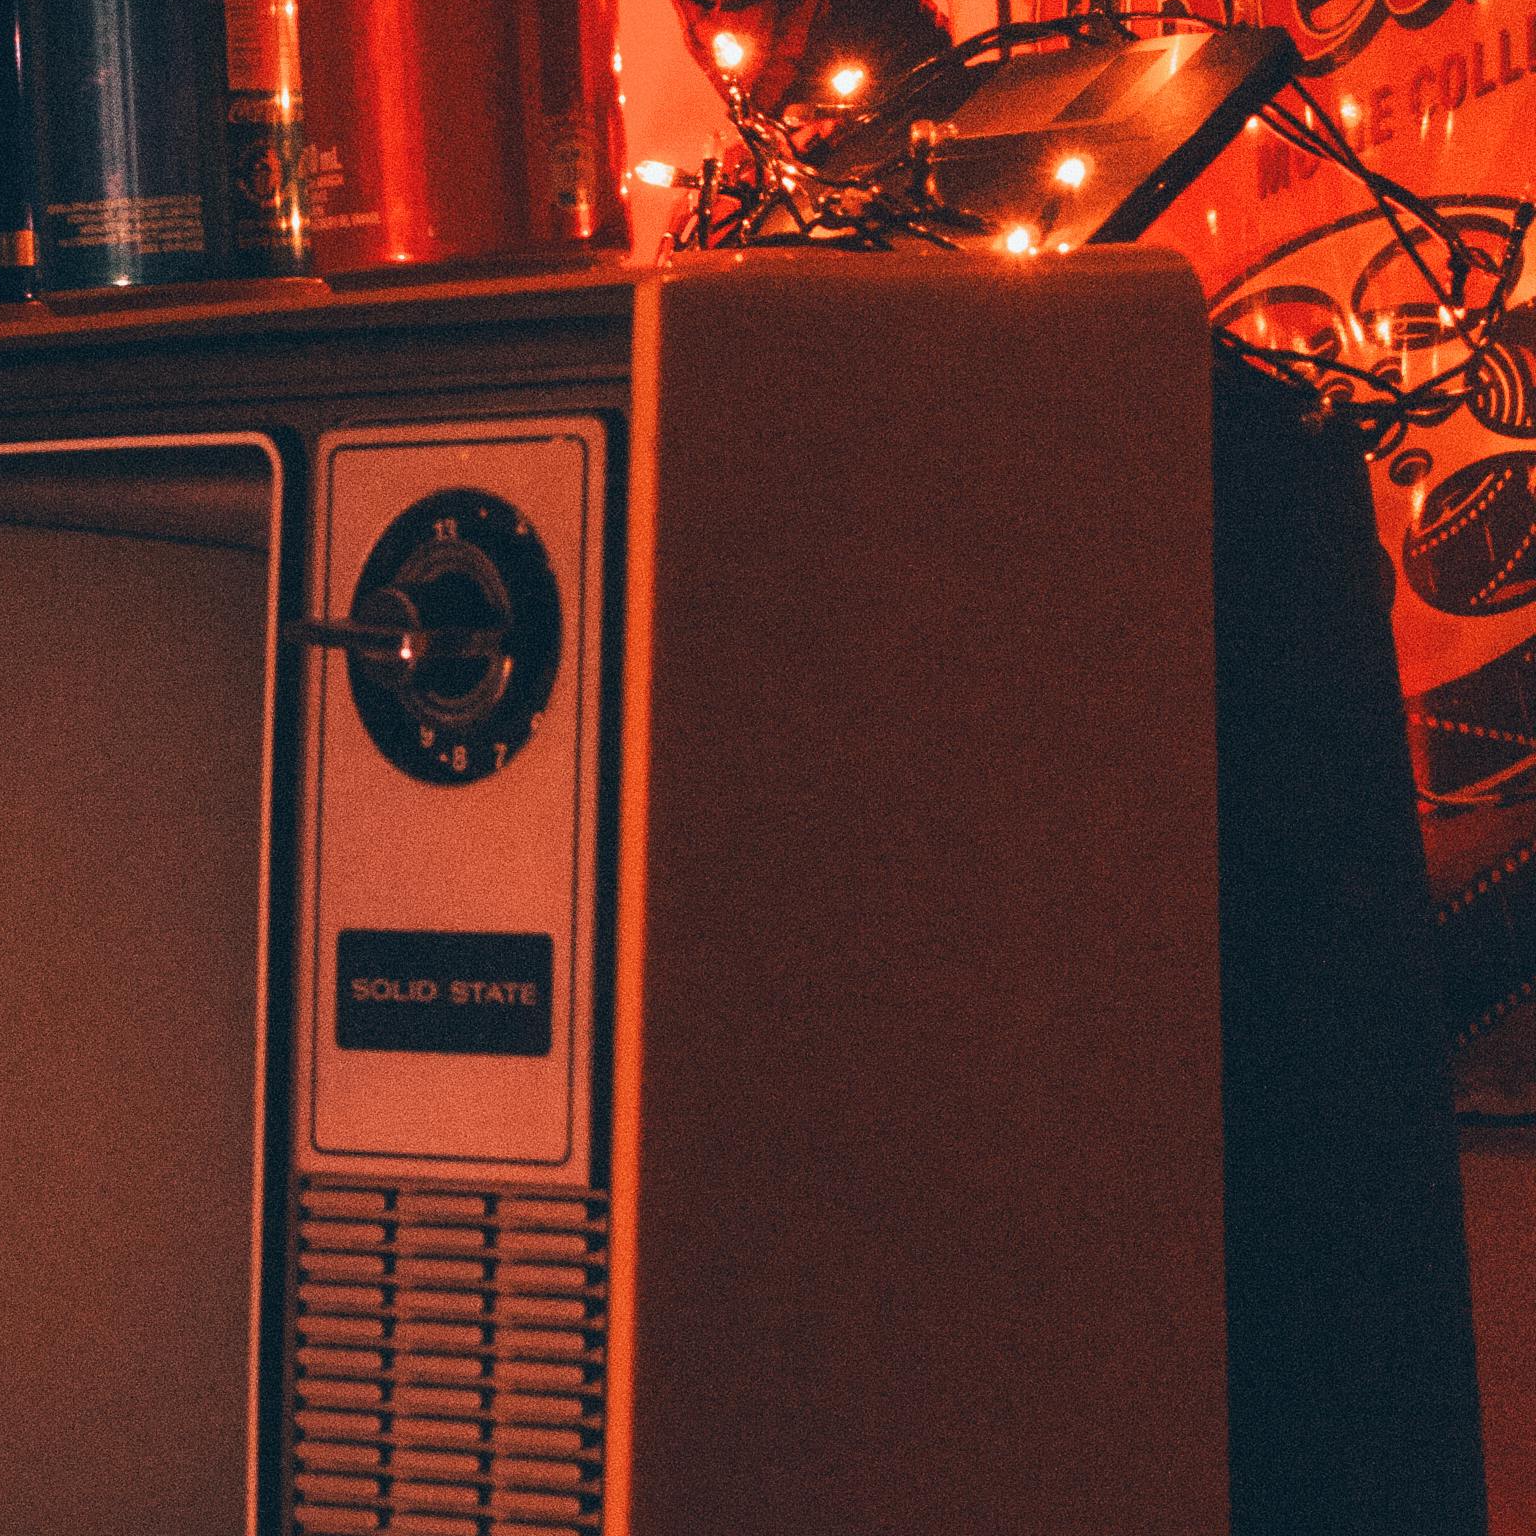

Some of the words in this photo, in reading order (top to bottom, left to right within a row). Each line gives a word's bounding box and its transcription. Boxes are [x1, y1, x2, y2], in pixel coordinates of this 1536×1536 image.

[451, 745, 468, 773] 8
[350, 977, 438, 1002] SOLID
[449, 979, 537, 1006] STATE
